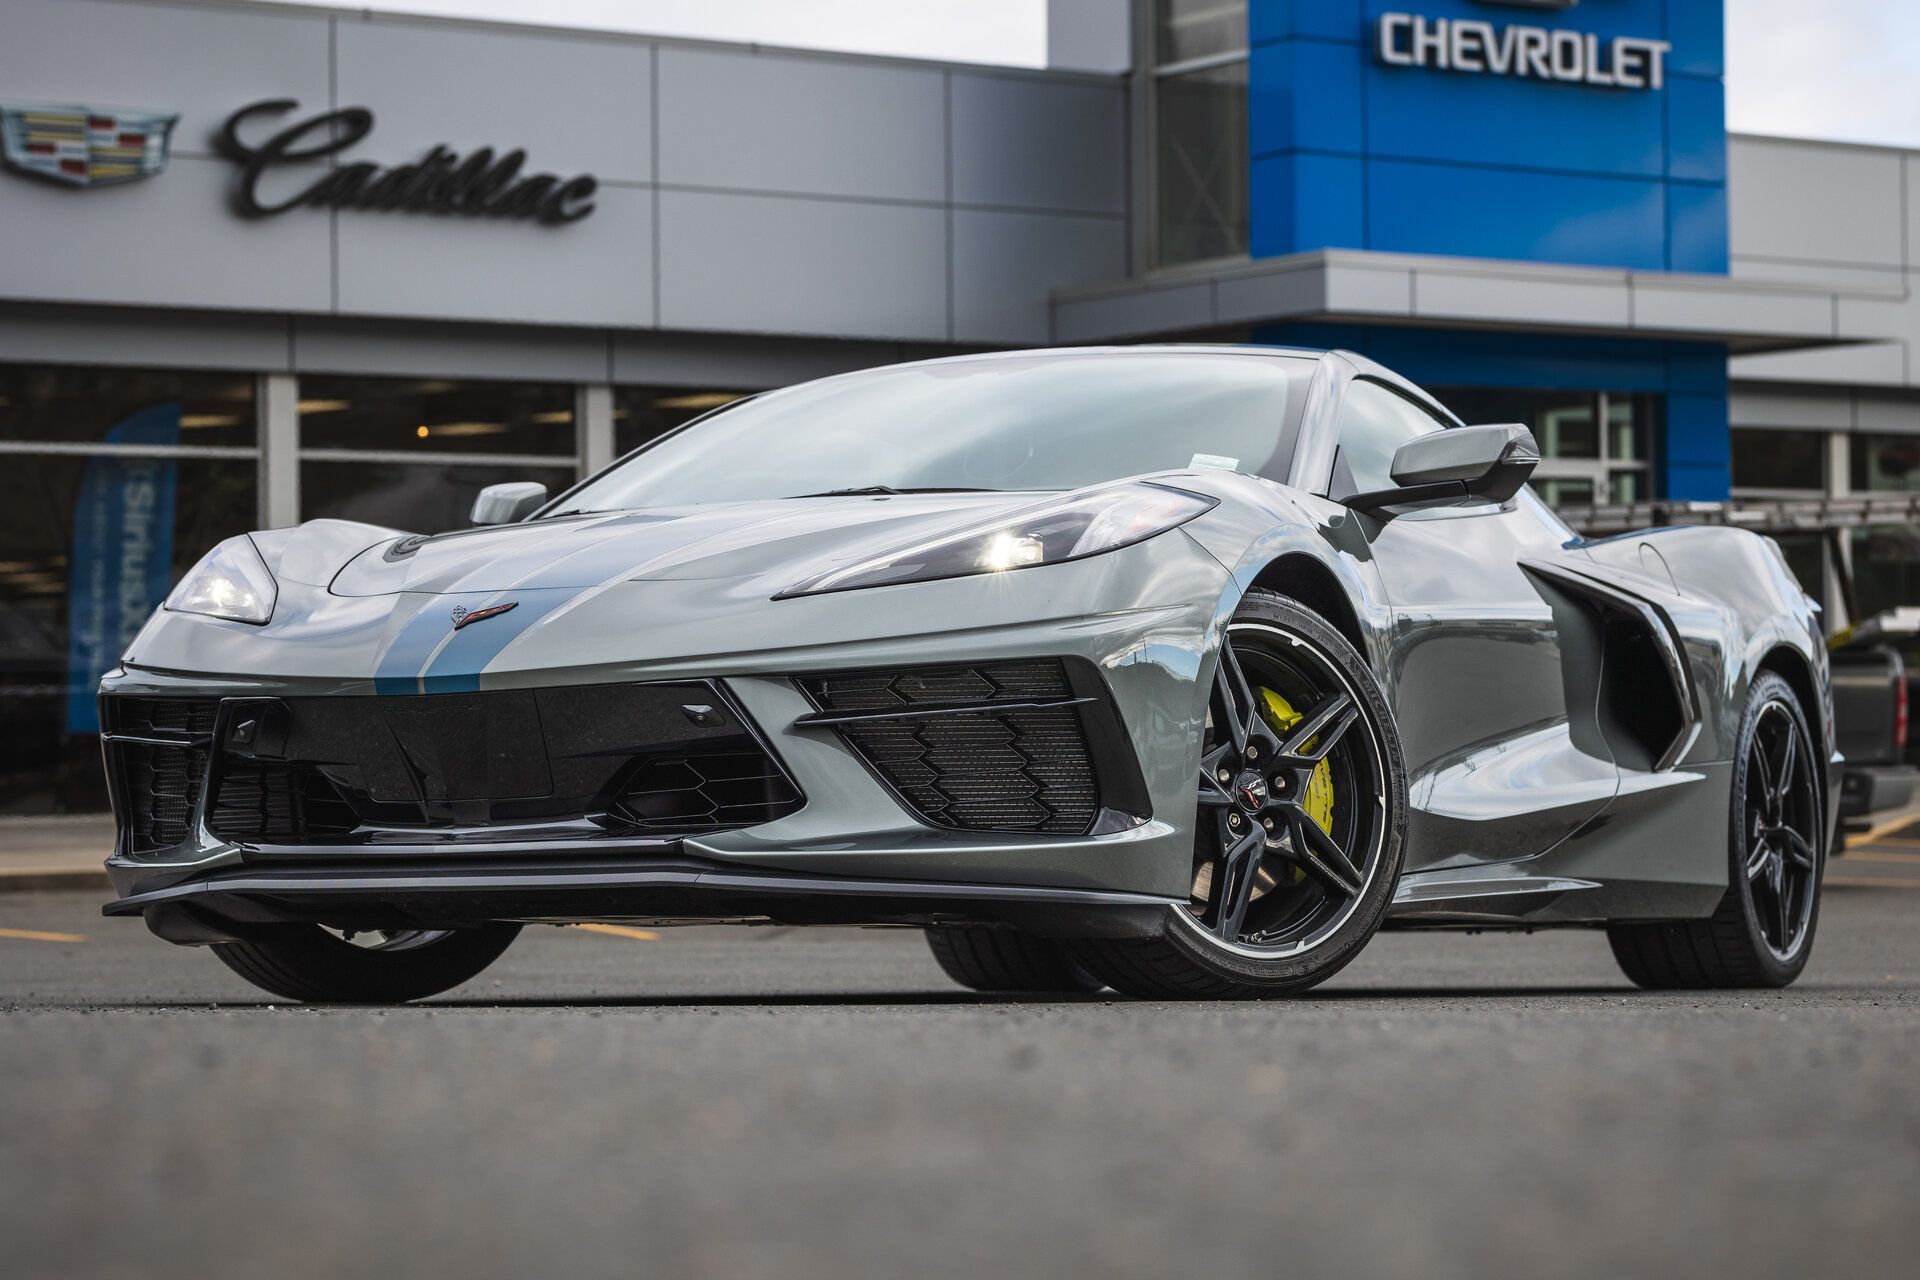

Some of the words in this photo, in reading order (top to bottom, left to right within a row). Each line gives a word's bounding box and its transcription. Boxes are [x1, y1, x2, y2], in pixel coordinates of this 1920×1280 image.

[1379, 12, 1671, 90] CHEVROLET
[212, 98, 598, 224] Cadillac
[117, 481, 157, 648] SiriusX
